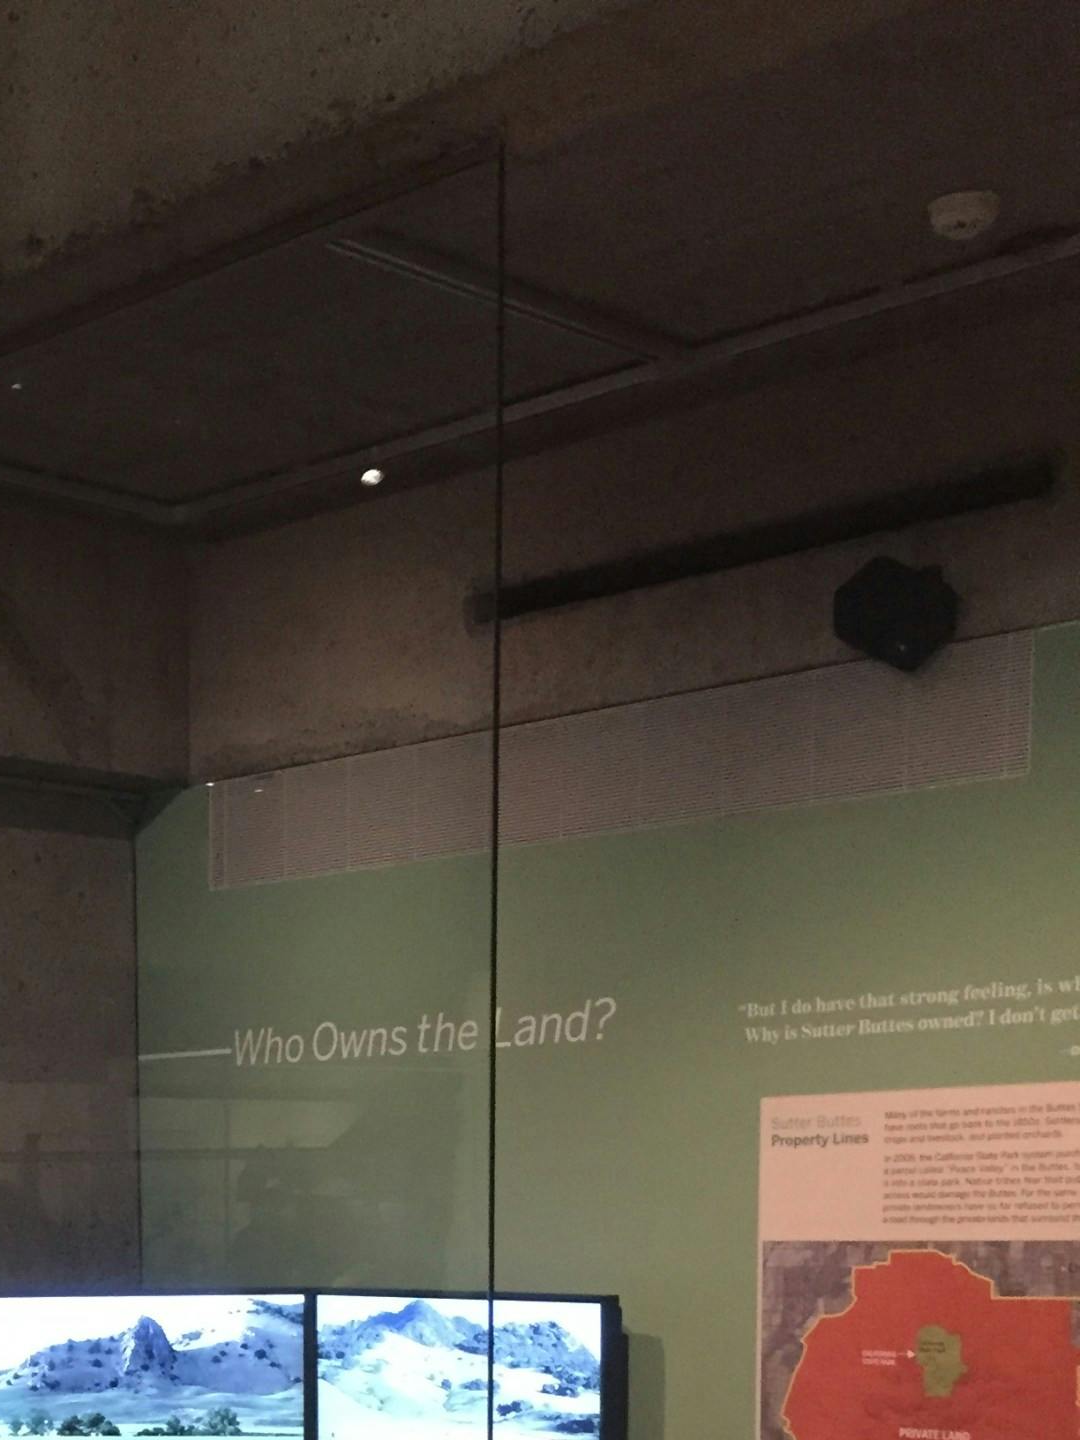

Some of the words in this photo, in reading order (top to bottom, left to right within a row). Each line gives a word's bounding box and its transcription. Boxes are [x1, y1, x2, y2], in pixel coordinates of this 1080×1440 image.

[781, 1002, 789, 1015] I
[792, 1000, 812, 1014] do
[816, 997, 856, 1012] have
[860, 993, 894, 1009] that
[900, 989, 959, 1007] strong
[1037, 977, 1054, 995] is
[234, 1028, 302, 1066] Who
[312, 1021, 407, 1061] Owns
[417, 1013, 478, 1051] the
[496, 996, 617, 1048] Land?
[745, 1027, 779, 1045] Why
[784, 1025, 798, 1040] is
[801, 1023, 856, 1039] Sutter
[858, 1018, 914, 1035] Buttes
[918, 1010, 985, 1031] owned?
[989, 1010, 996, 1025] I
[771, 1116, 813, 1131] Sutter
[817, 1114, 862, 1129] Buttes
[771, 1133, 829, 1148] Property
[832, 1131, 869, 1145] Lines
